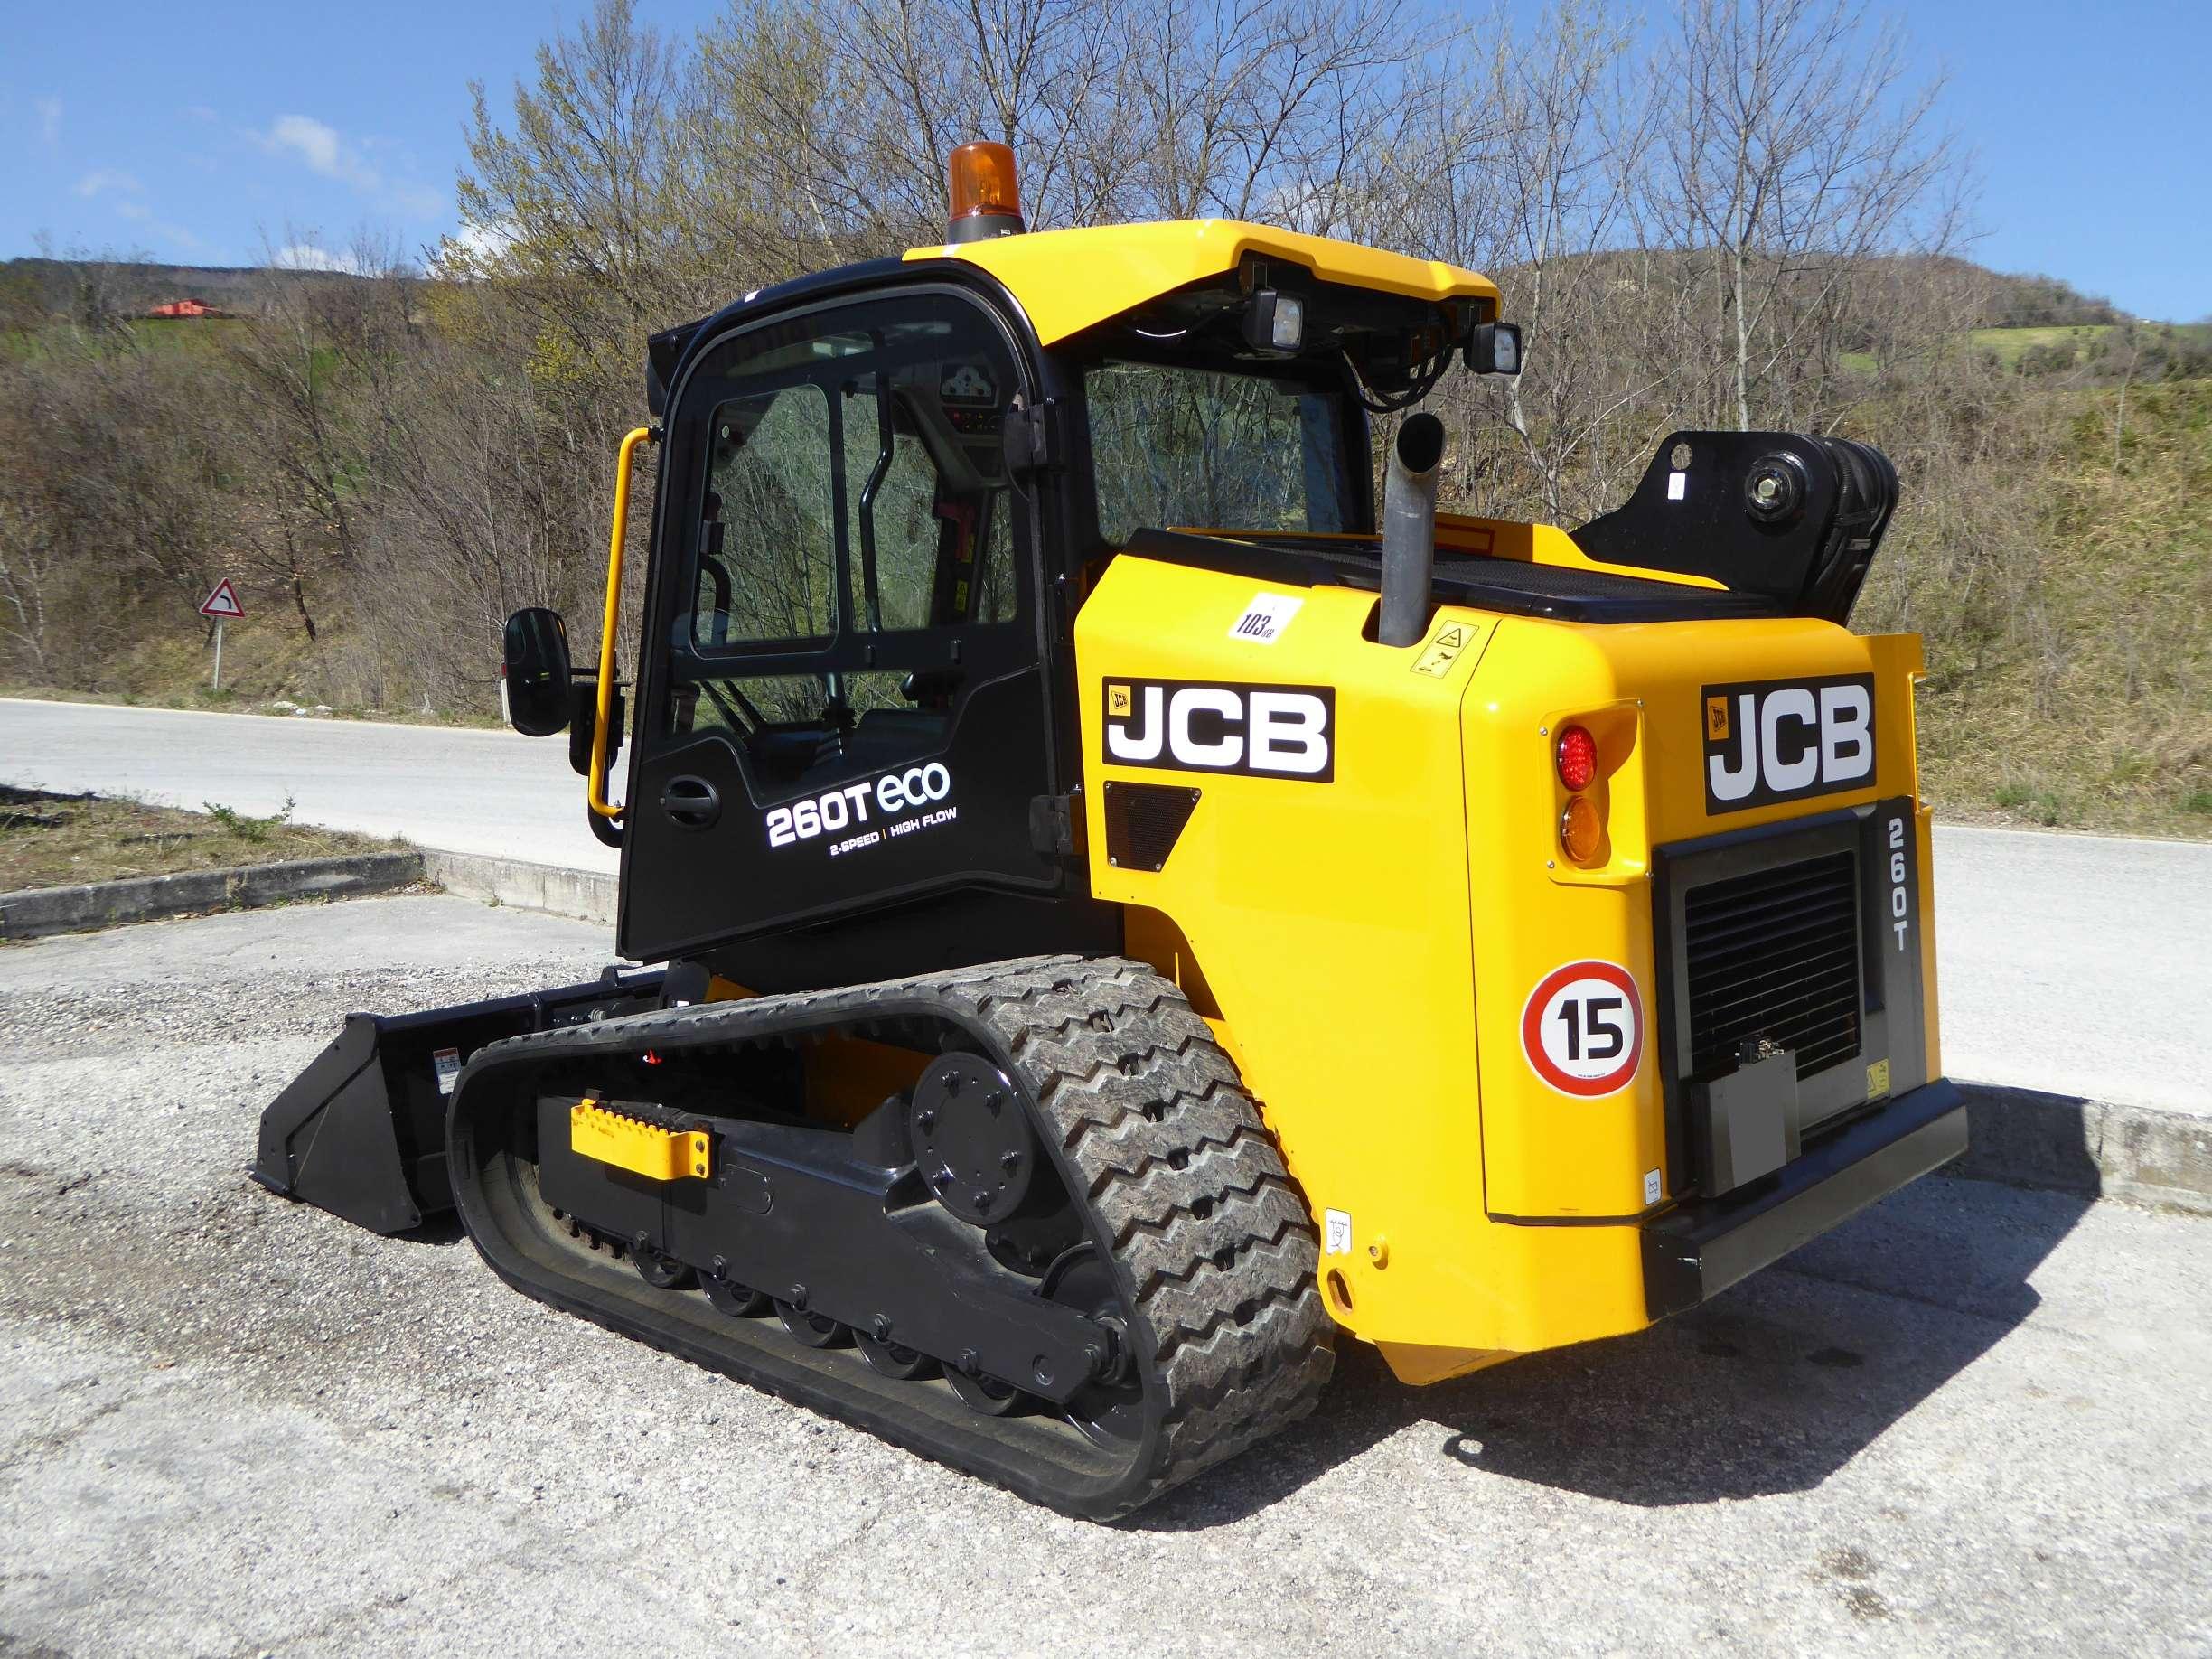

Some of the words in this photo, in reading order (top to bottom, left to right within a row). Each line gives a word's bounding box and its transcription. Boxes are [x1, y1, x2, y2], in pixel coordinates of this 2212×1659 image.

[1237, 613, 1272, 636] 103
[1108, 686, 1328, 773] JCB
[1114, 693, 1129, 708] JCB
[1709, 684, 1872, 801] JCB
[766, 782, 872, 848] 260T
[876, 762, 951, 812] eco
[830, 831, 880, 856] 2-SPEED
[890, 818, 921, 837] HIGH
[923, 807, 957, 828] FLOW
[1889, 817, 1908, 951] 260T
[1557, 997, 1624, 1061] 15
